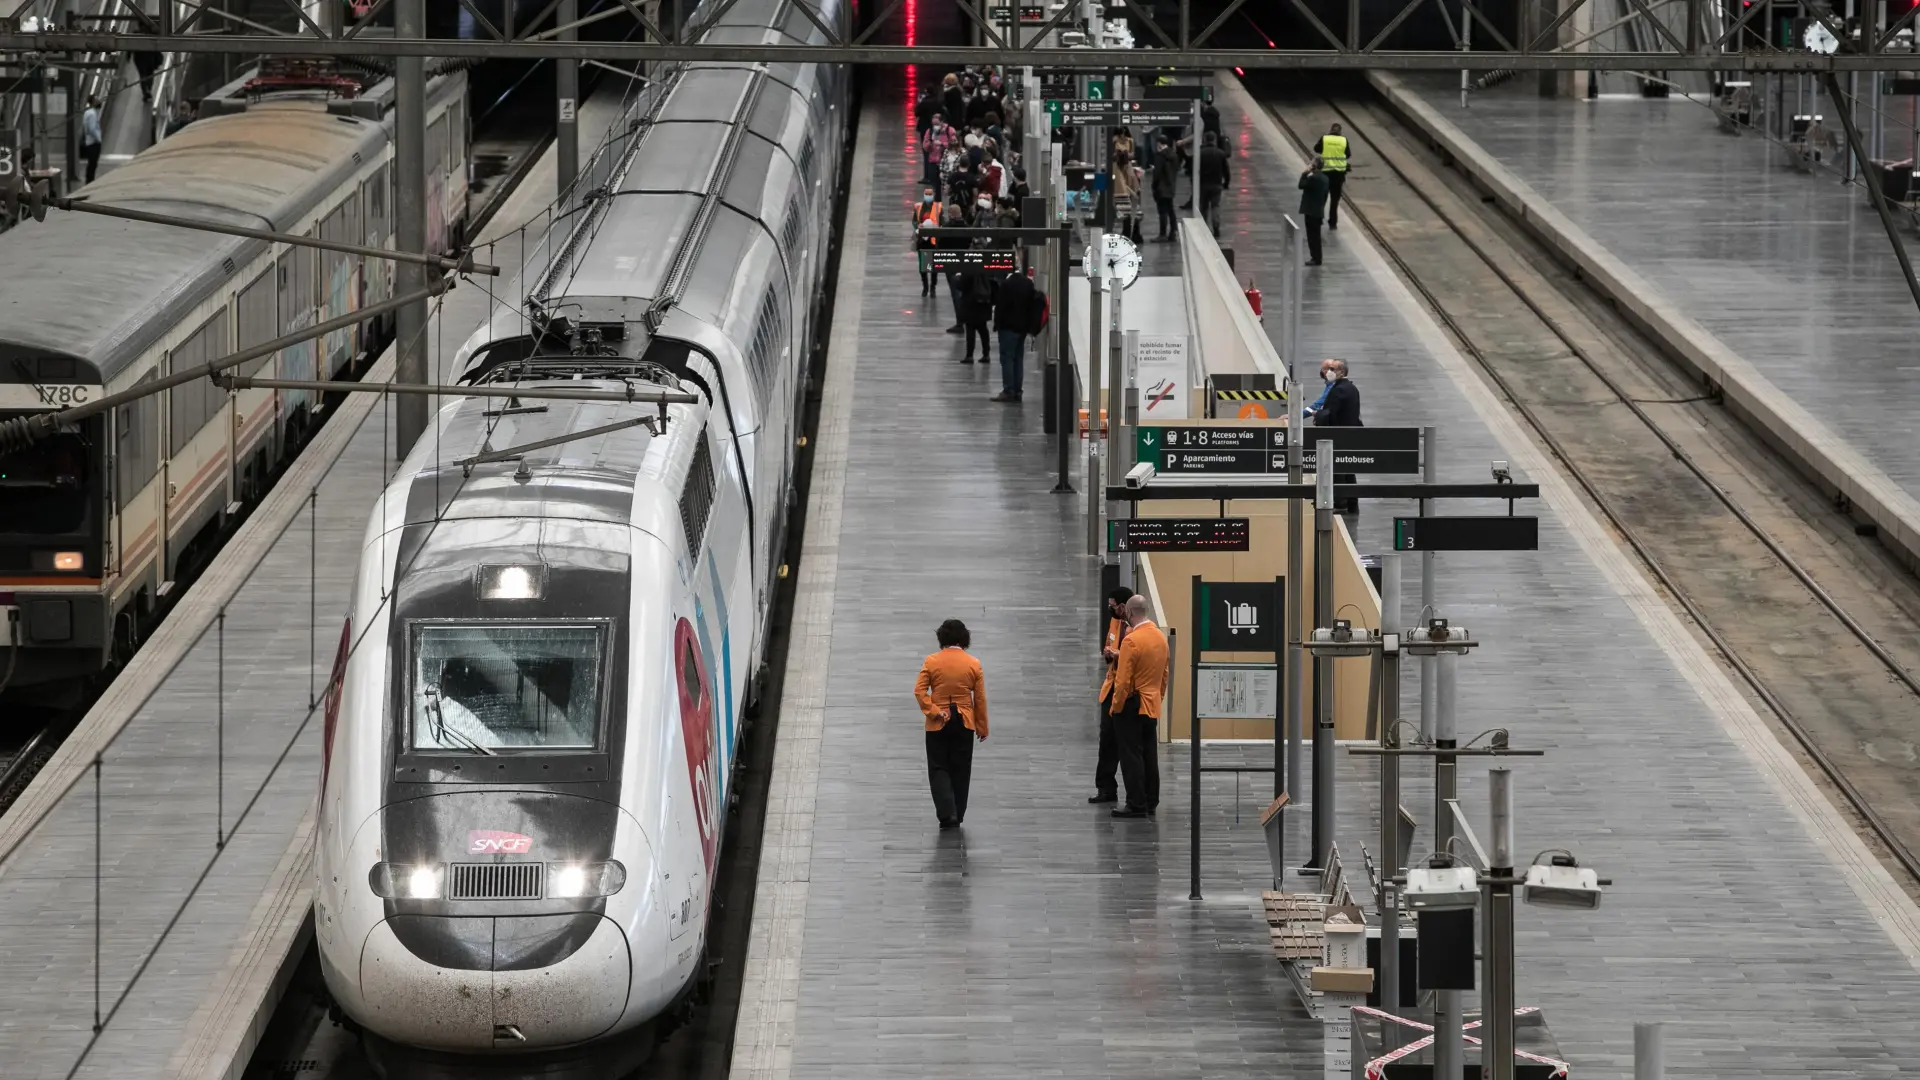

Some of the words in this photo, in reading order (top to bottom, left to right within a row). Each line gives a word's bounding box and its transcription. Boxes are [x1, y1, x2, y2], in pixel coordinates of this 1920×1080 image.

[1212, 431, 1237, 439] Acceso
[1239, 431, 1254, 439] vías
[1183, 454, 1236, 463] Aparcamiento
[1118, 538, 1126, 549] 4
[1407, 536, 1414, 549] 3
[471, 838, 529, 851] SNCF
